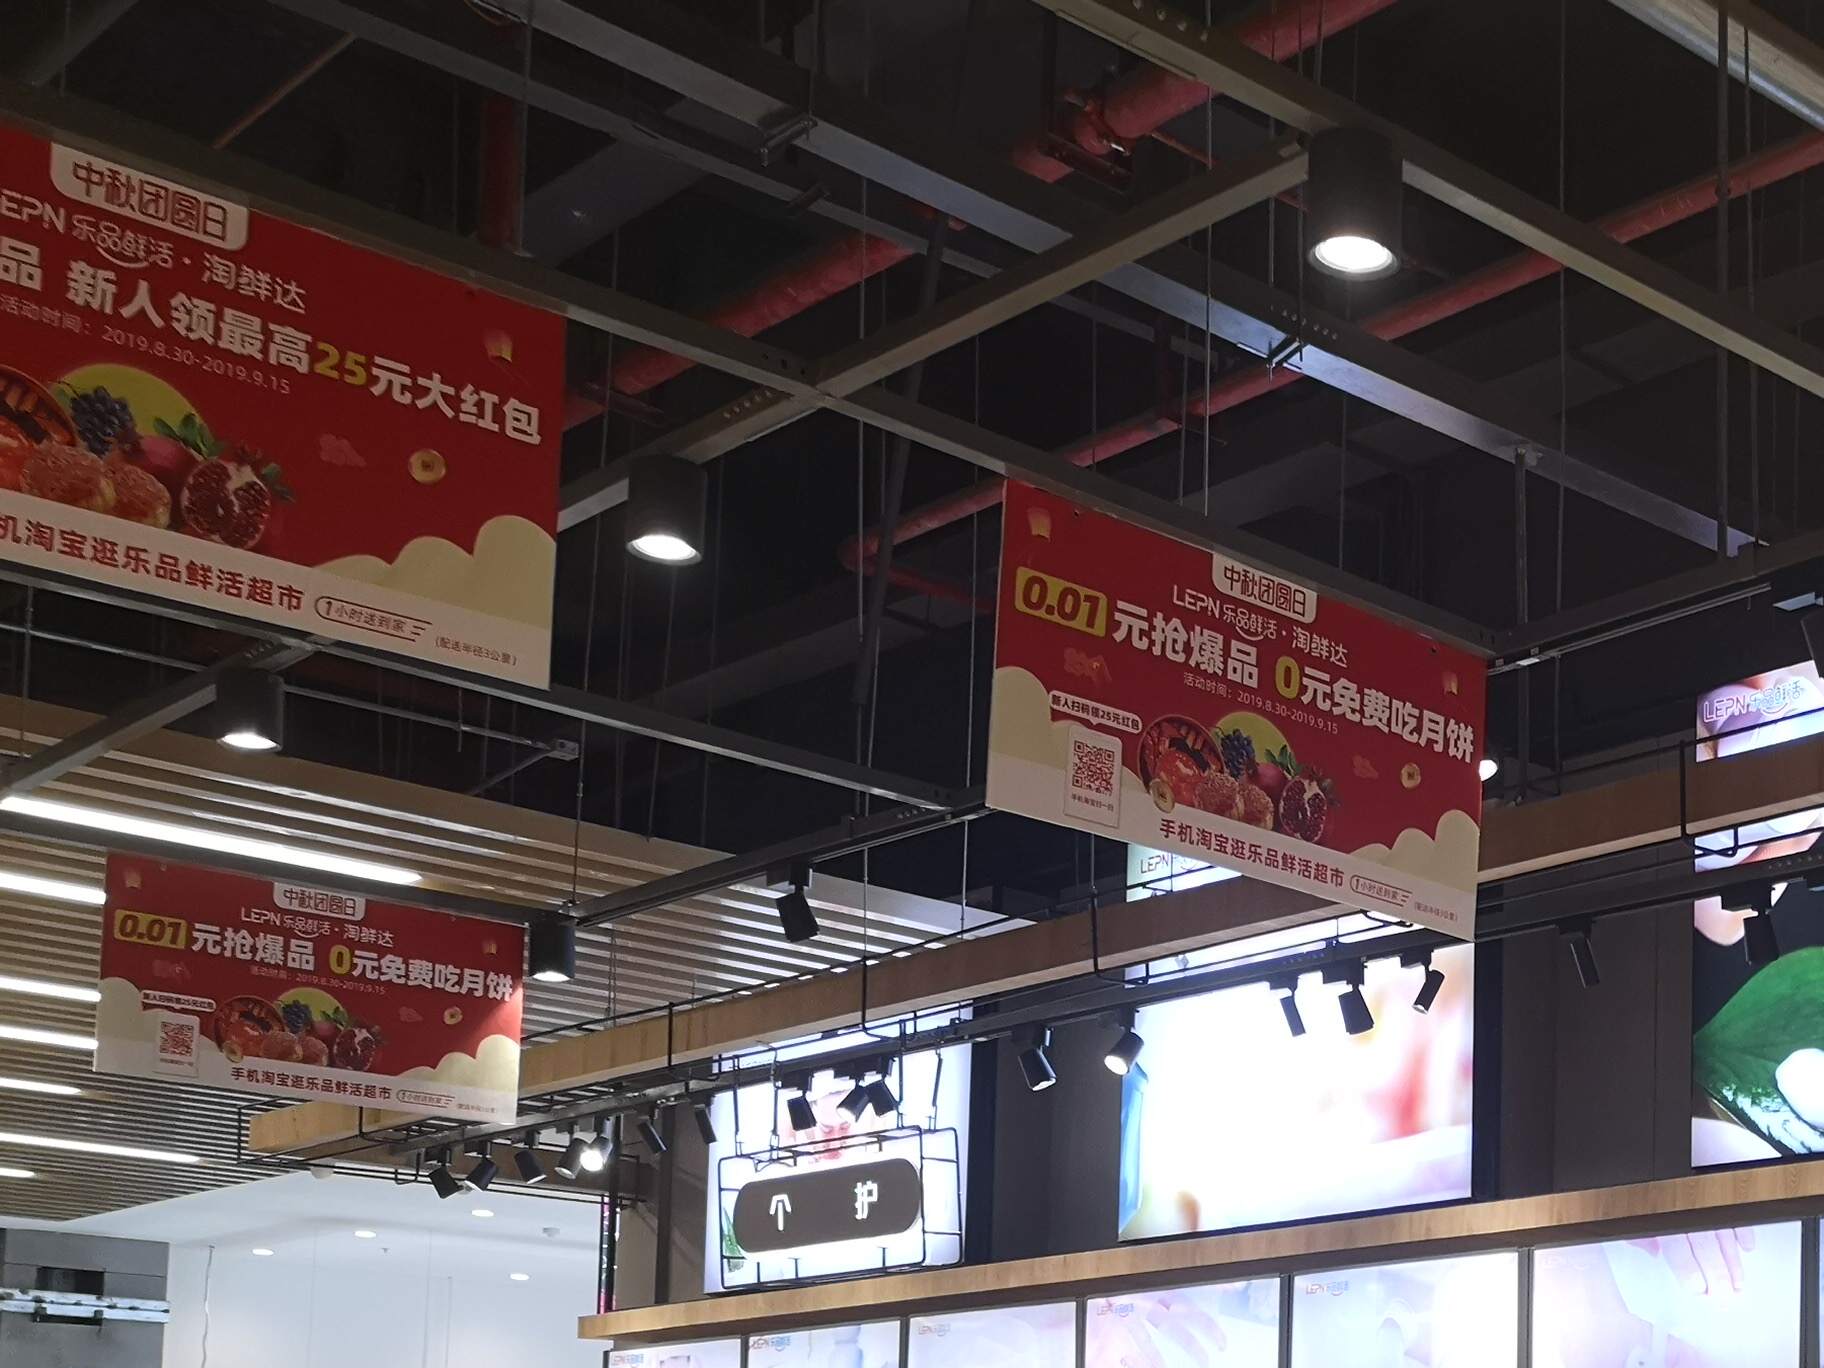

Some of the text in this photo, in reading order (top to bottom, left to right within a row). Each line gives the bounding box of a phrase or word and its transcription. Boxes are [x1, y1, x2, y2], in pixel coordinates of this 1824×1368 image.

[73, 161, 227, 242] 中秋团圆日
[72, 214, 173, 269] 乐品鲜活
[202, 251, 306, 314] 淘鲜达
[66, 260, 541, 445] 新人领最高25元大红包
[1224, 565, 1307, 617] 中秋团圆日
[1173, 584, 1348, 668] LEPN 乐品鲜活 淘鲜达
[1051, 694, 1140, 731] 新人扫码领25元红包
[1275, 655, 1475, 763] 0元免费吃月饼
[1704, 695, 1746, 722] LEPN
[1140, 854, 1169, 874] LEPN
[1159, 818, 1345, 888] 手机淘宝逛乐品鲜活超市
[241, 907, 395, 948] LEPN 乐品鲜活 淘鲜达
[283, 888, 356, 917] 中秋团圆日
[329, 943, 513, 1003] 0元免费吃月饼
[231, 1066, 391, 1102] 手机淘宝逛乐品鲜活超市
